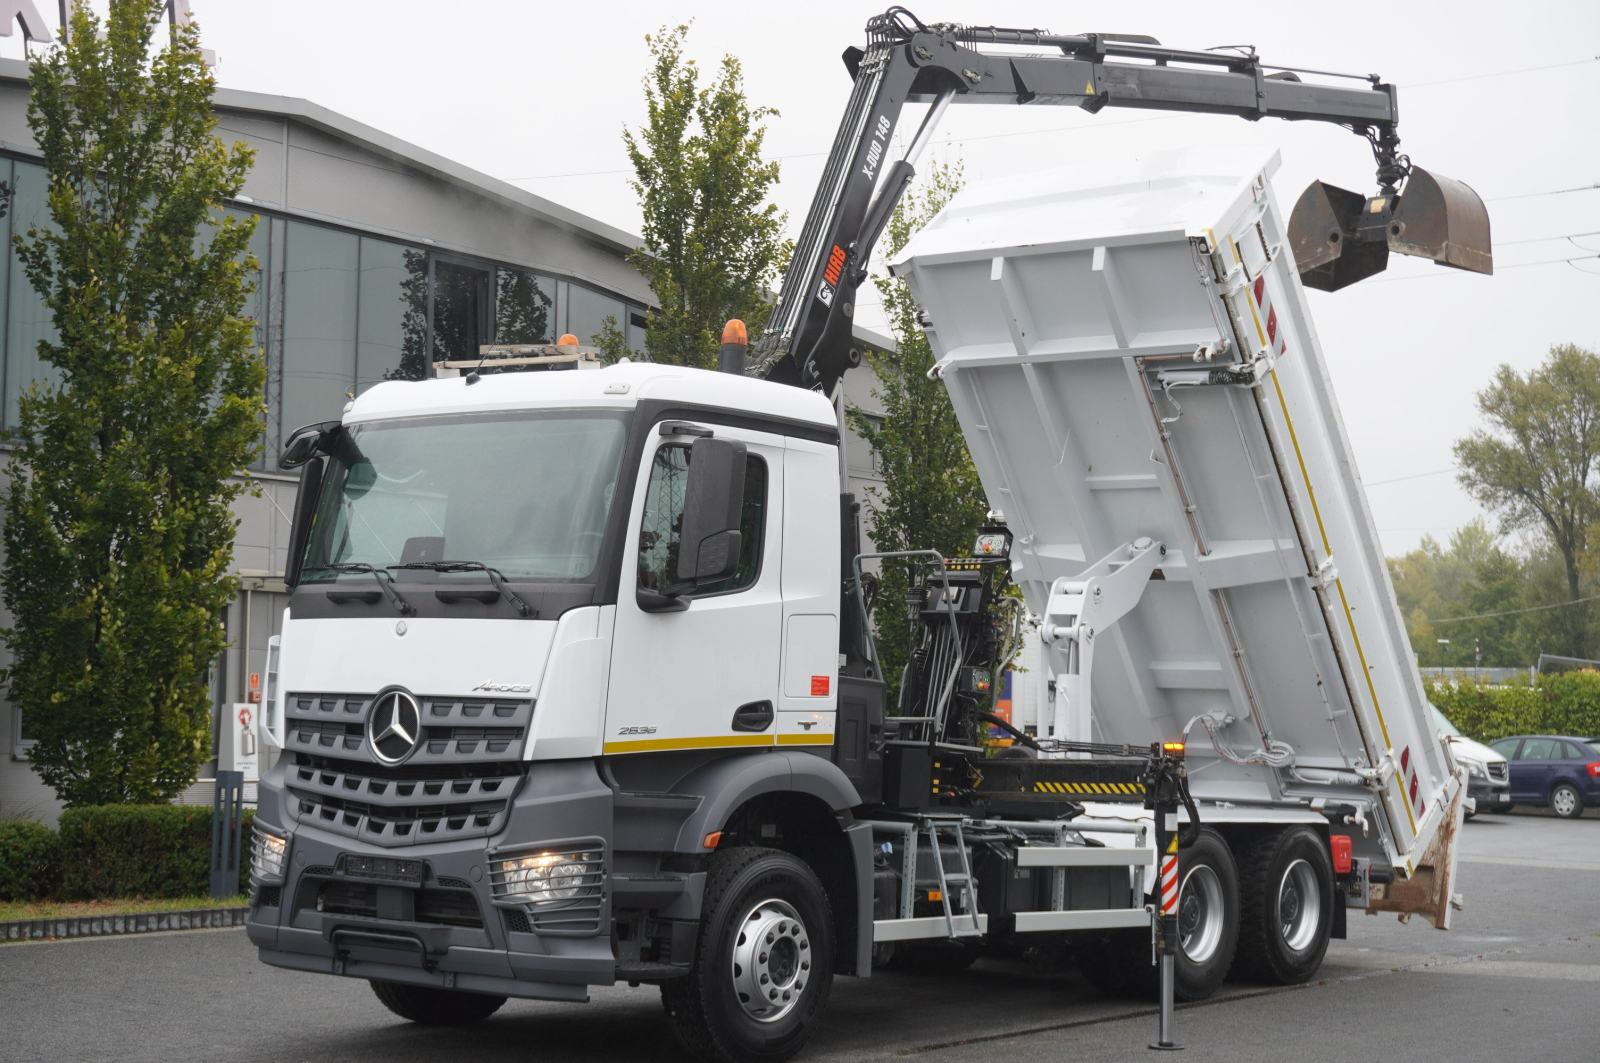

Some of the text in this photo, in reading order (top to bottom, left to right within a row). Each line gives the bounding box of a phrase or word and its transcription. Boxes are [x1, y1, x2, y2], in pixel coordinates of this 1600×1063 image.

[862, 115, 891, 180] X-DUO 148
[823, 244, 847, 287] HIAB
